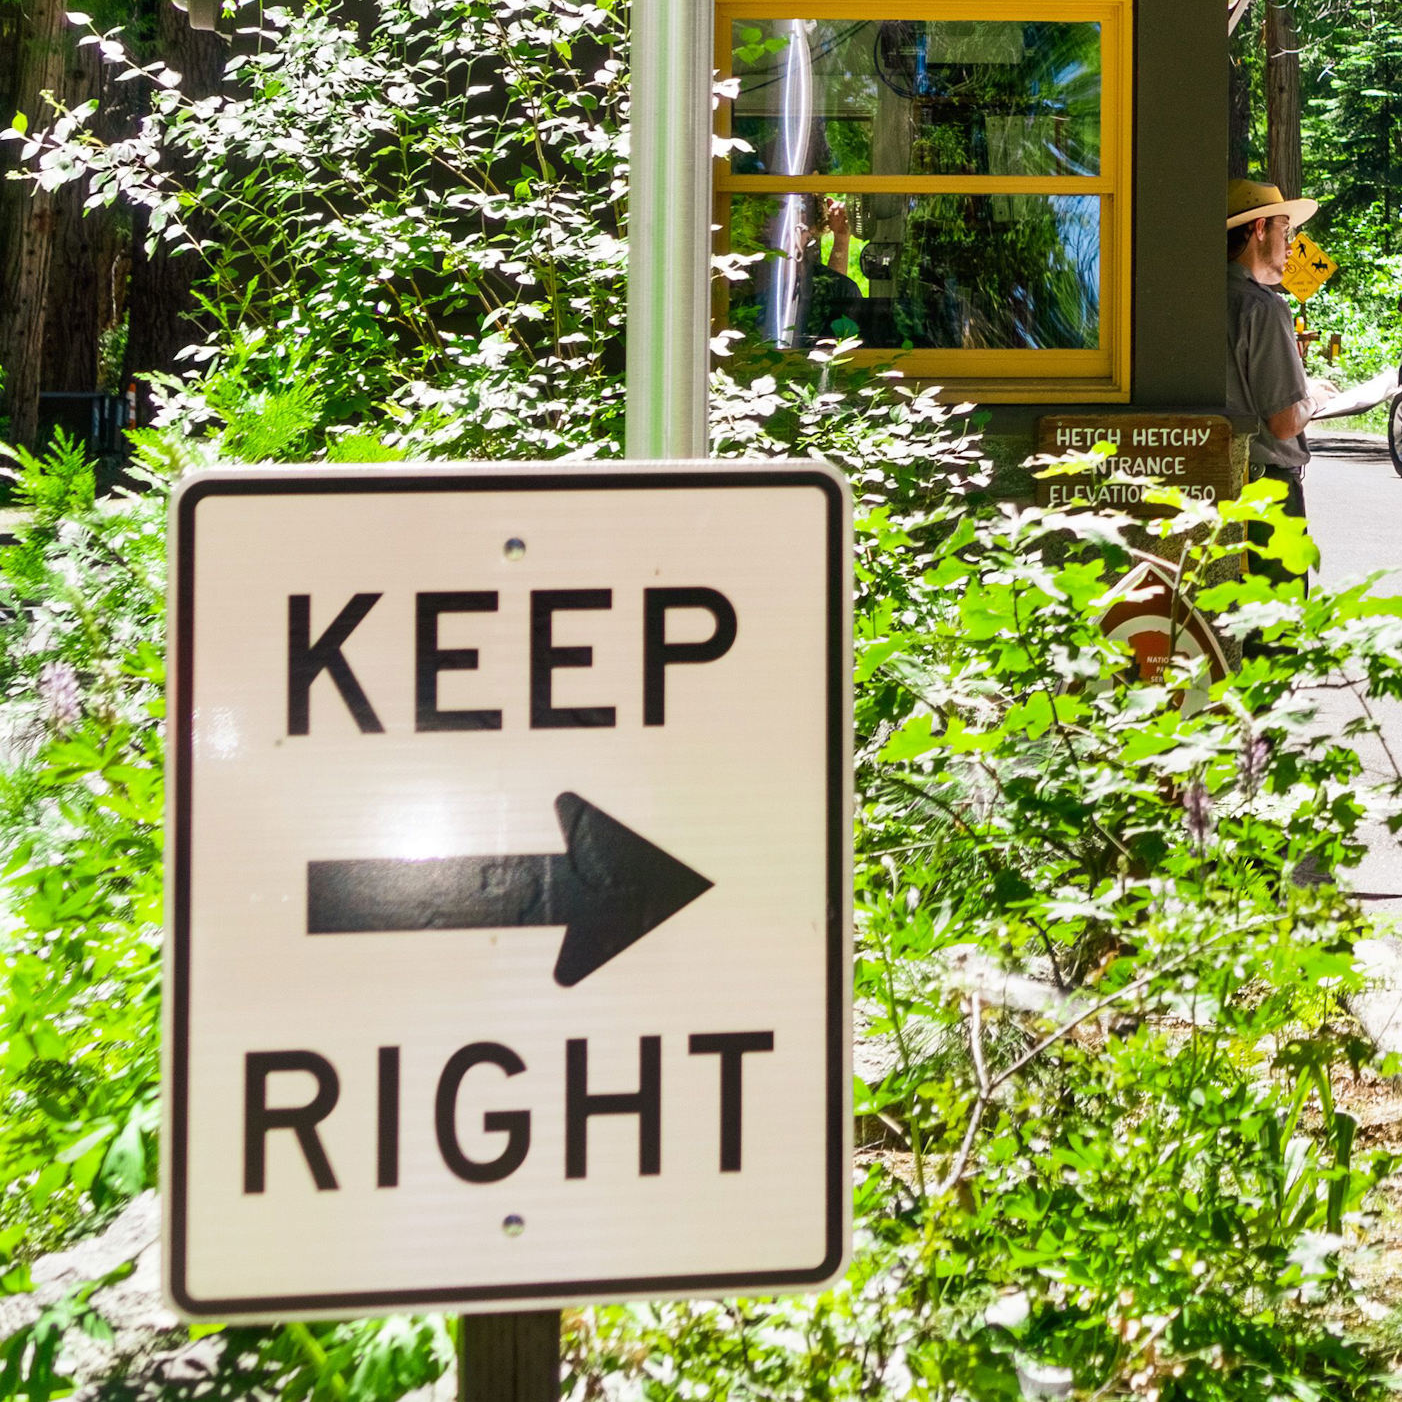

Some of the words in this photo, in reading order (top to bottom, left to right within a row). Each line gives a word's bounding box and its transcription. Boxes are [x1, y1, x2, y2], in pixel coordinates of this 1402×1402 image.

[1056, 428, 1121, 446] HETCH
[1132, 428, 1211, 446] HETCHY
[1081, 456, 1186, 475] NTRANCE
[1049, 485, 1154, 503] ELEVATIO
[285, 586, 739, 737] KEEP
[1146, 655, 1170, 664] NATIO
[241, 1030, 776, 1196] RIGHT
